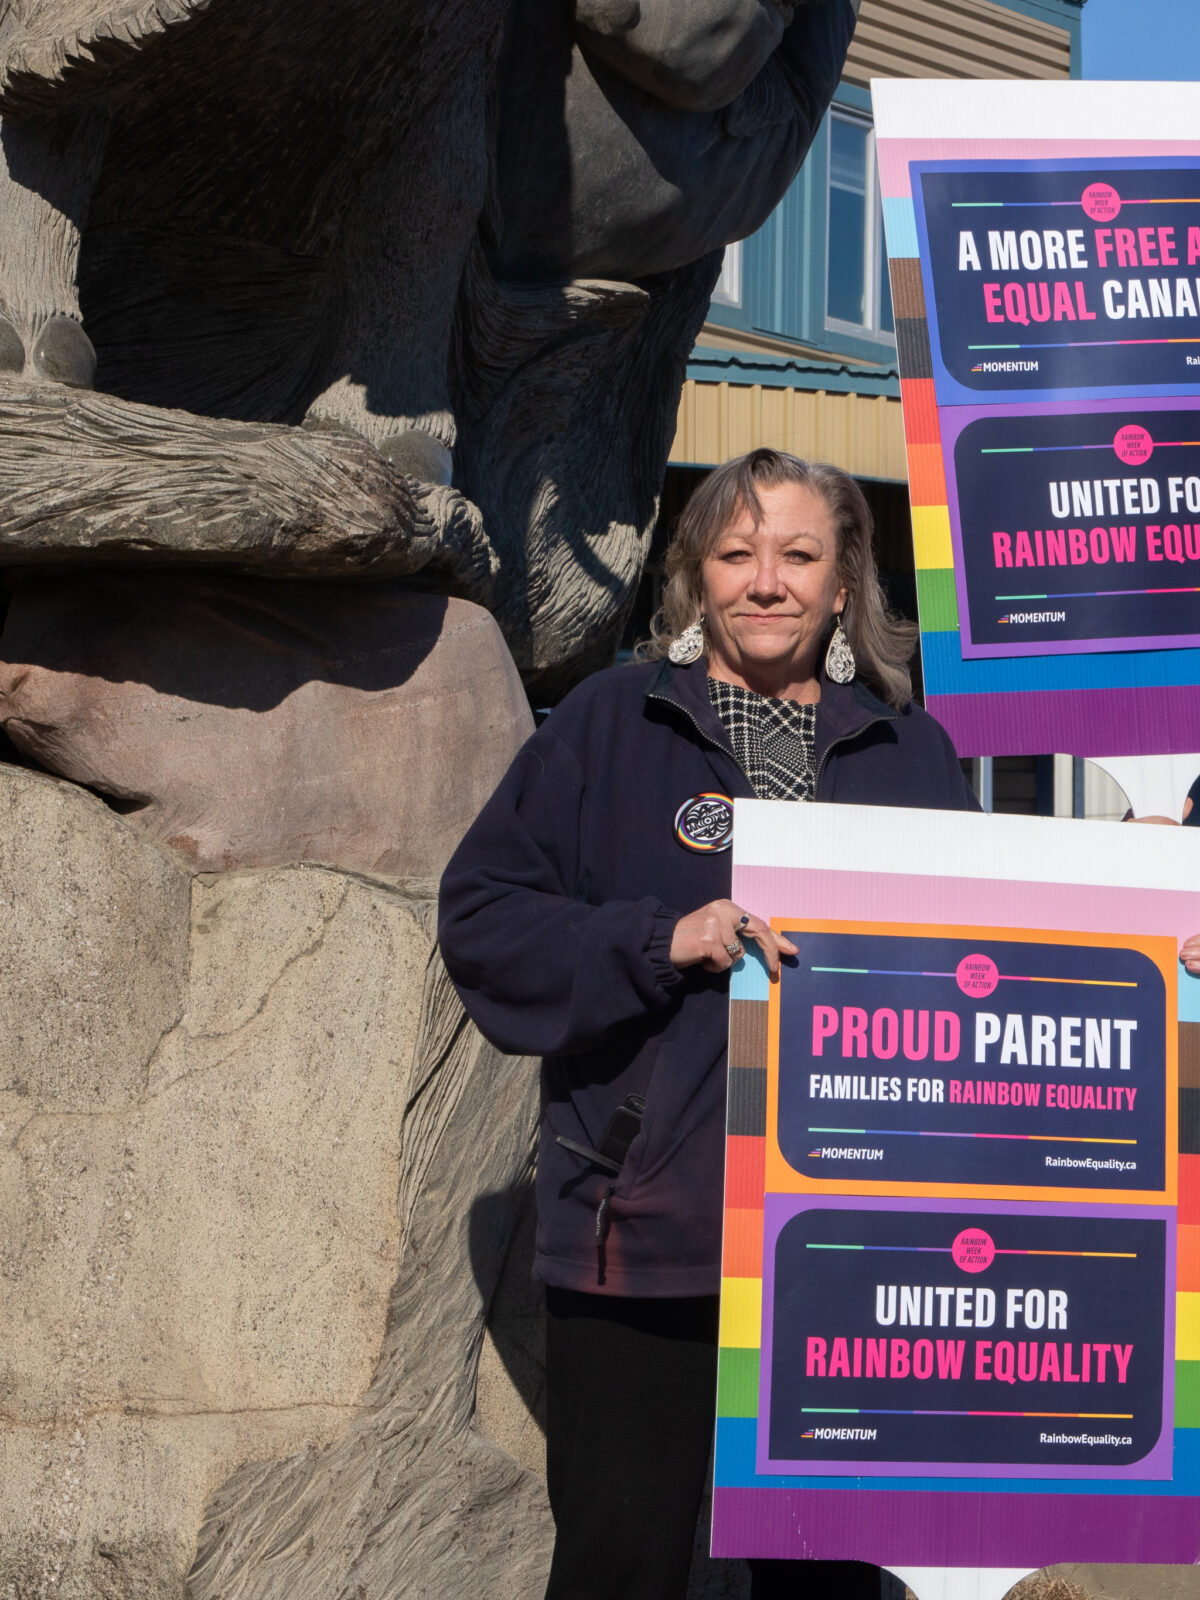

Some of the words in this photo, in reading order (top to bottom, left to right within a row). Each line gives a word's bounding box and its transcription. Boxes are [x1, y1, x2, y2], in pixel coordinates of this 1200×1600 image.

[959, 231, 981, 270] A
[988, 230, 1088, 270] MORE
[1095, 227, 1178, 267] FREE
[984, 282, 1096, 325] EQUAL
[983, 362, 1038, 372] MOMENTUM
[1050, 479, 1160, 518] UNITED
[993, 527, 1136, 567] RAINBOW
[1010, 612, 1065, 623] MOMENTUM
[813, 1006, 960, 1061] PROUD
[975, 1013, 1137, 1069] PARENT
[810, 1075, 901, 1101] FAMILIES
[907, 1079, 944, 1102] FOR
[950, 1080, 1040, 1106] RAINBOW
[1047, 1084, 1136, 1110] EQUALITY
[822, 1148, 883, 1160] MOMENTUM
[1046, 1157, 1136, 1171] RainbowEquality.ca
[876, 1286, 995, 1327] UNITED
[1007, 1289, 1067, 1329] FOR
[807, 1337, 965, 1379] RAINBOW
[975, 1341, 1133, 1384] EQUALITY
[815, 1429, 876, 1440] MOMENTUM
[1040, 1433, 1132, 1446] RainbowEquality.ca
